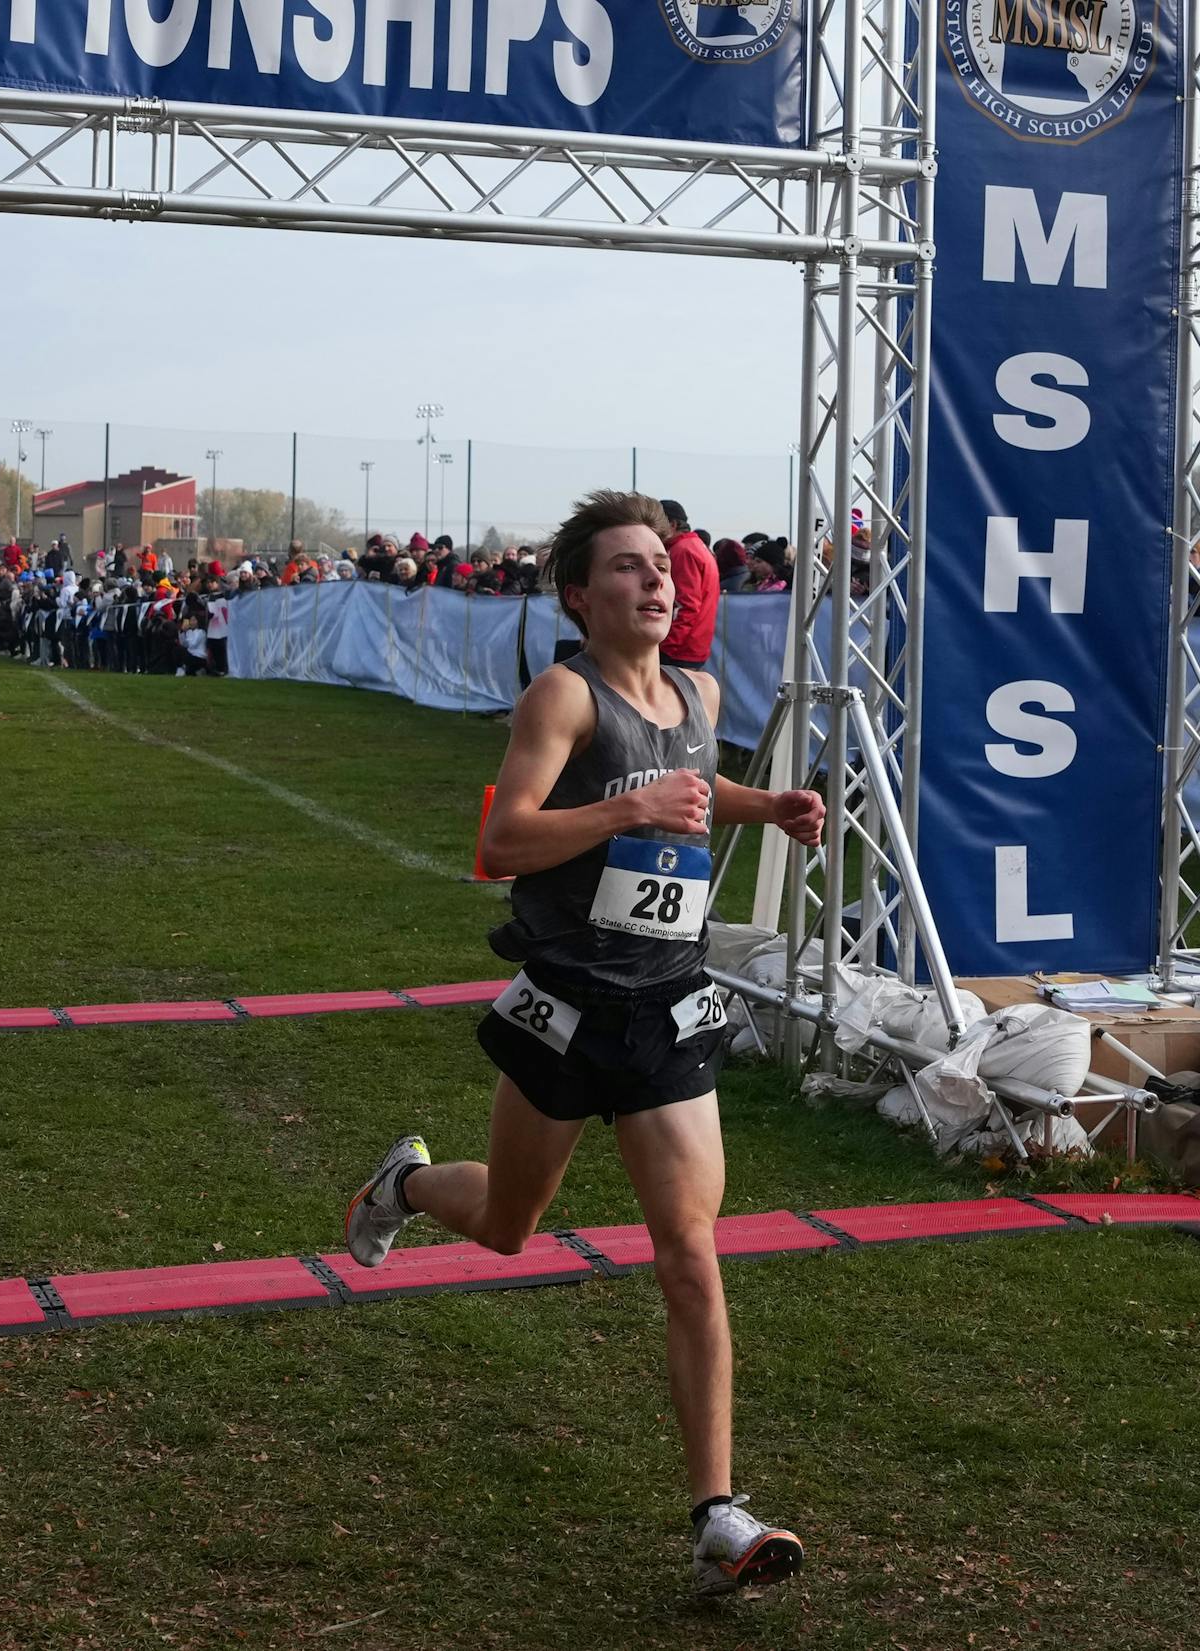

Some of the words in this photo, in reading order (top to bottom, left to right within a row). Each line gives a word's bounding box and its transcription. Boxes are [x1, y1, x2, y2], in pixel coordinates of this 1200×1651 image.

[676, 27, 709, 58] HIGH
[713, 41, 772, 60] SCHOOL
[947, 0, 973, 77] STATE
[967, 77, 1023, 129] HIGH
[1027, 107, 1112, 137] SCHOOL
[1109, 22, 1153, 110] LEAGUE
[982, 184, 1108, 943] MSHSL
[629, 878, 684, 924] 28
[599, 917, 622, 928] State
[624, 922, 638, 931] CC
[639, 925, 694, 939] Championships
[508, 988, 554, 1034] 28
[695, 989, 722, 1029] 28
